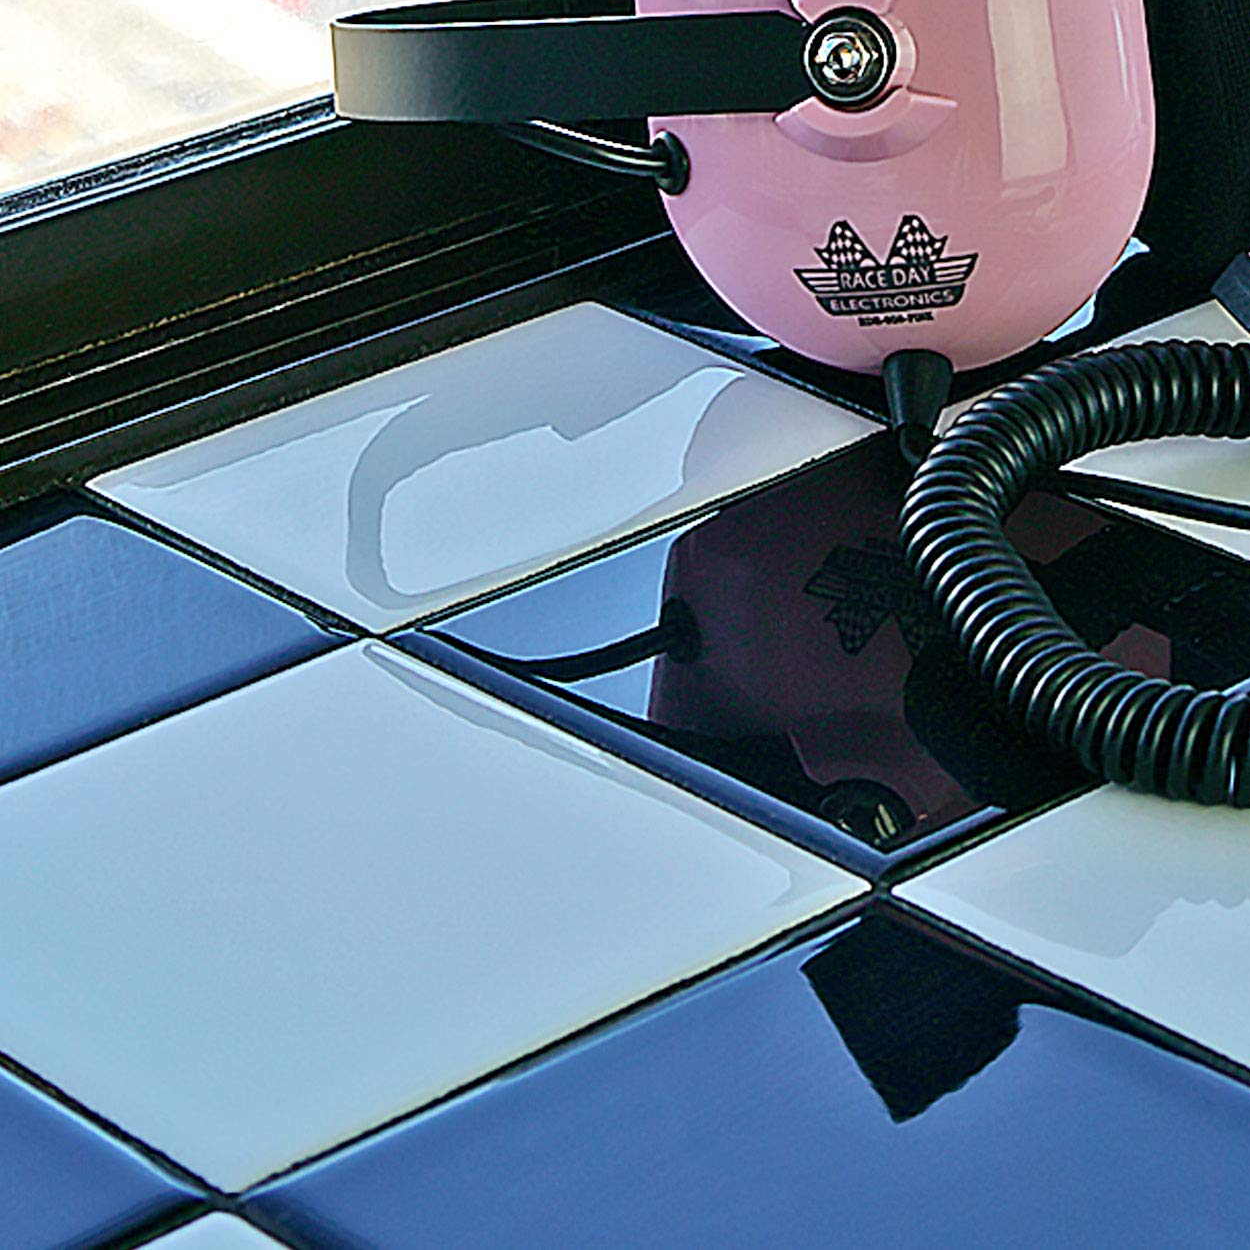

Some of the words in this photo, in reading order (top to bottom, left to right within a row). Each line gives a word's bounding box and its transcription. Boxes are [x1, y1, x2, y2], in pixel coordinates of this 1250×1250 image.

[840, 269, 888, 290] RACE
[892, 266, 931, 286] DAY
[829, 289, 955, 312] ELECTRONICS
